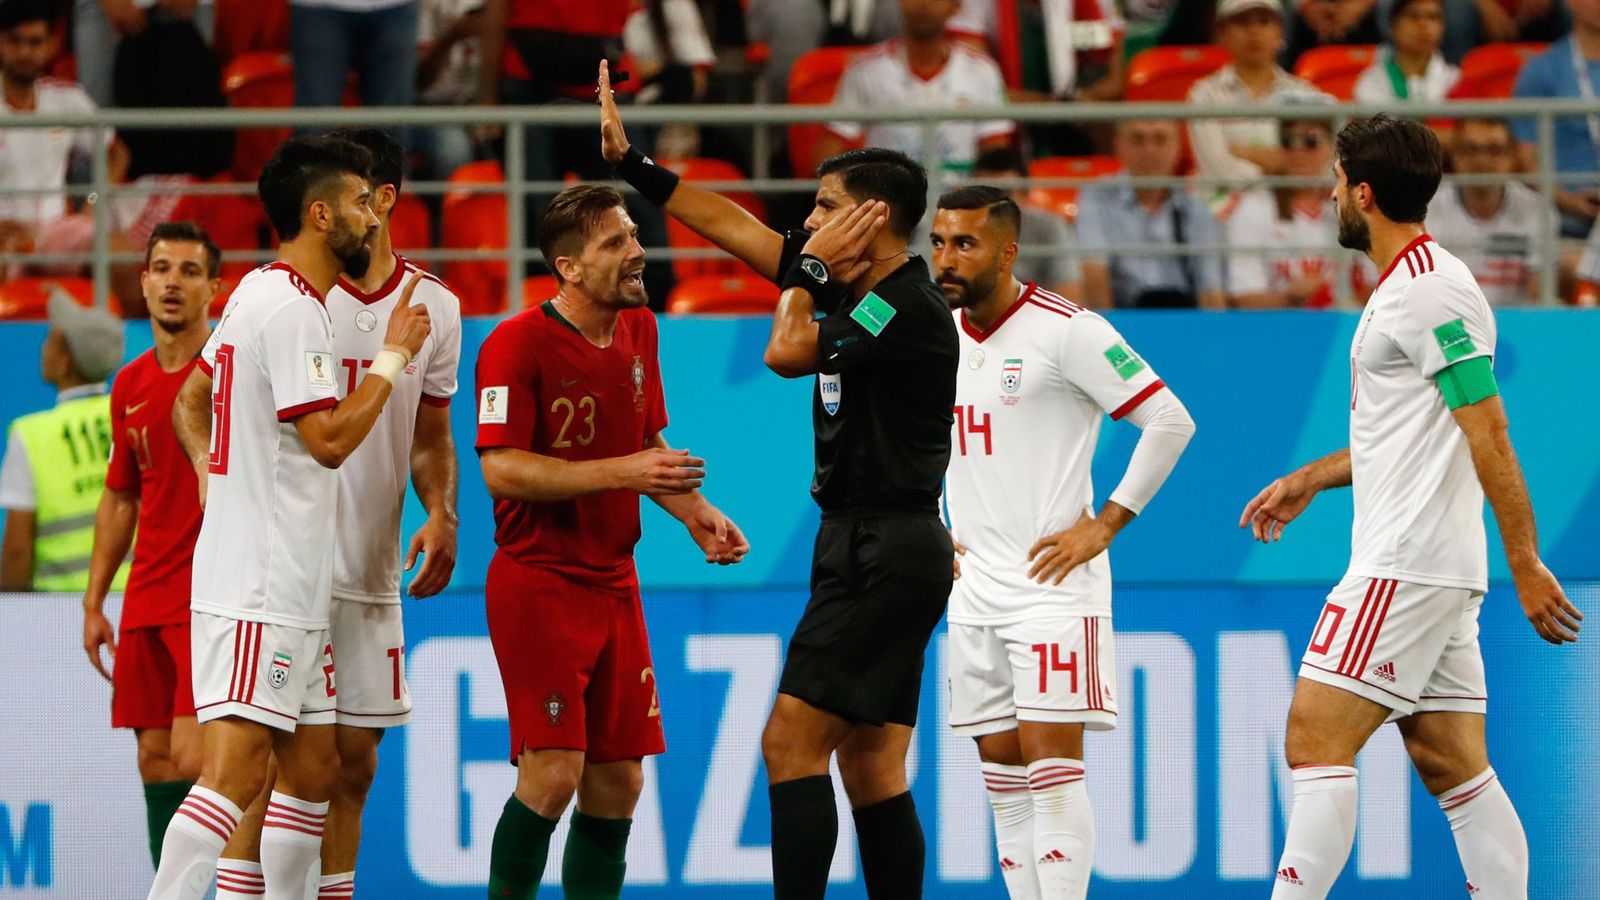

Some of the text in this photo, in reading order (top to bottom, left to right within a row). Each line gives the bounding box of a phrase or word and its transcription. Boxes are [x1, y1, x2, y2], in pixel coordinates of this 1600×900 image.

[822, 382, 839, 394] FIFA
[551, 396, 596, 448] 23
[952, 405, 993, 456] 14
[1031, 643, 1078, 693] 14
[1373, 669, 1397, 682] adidas
